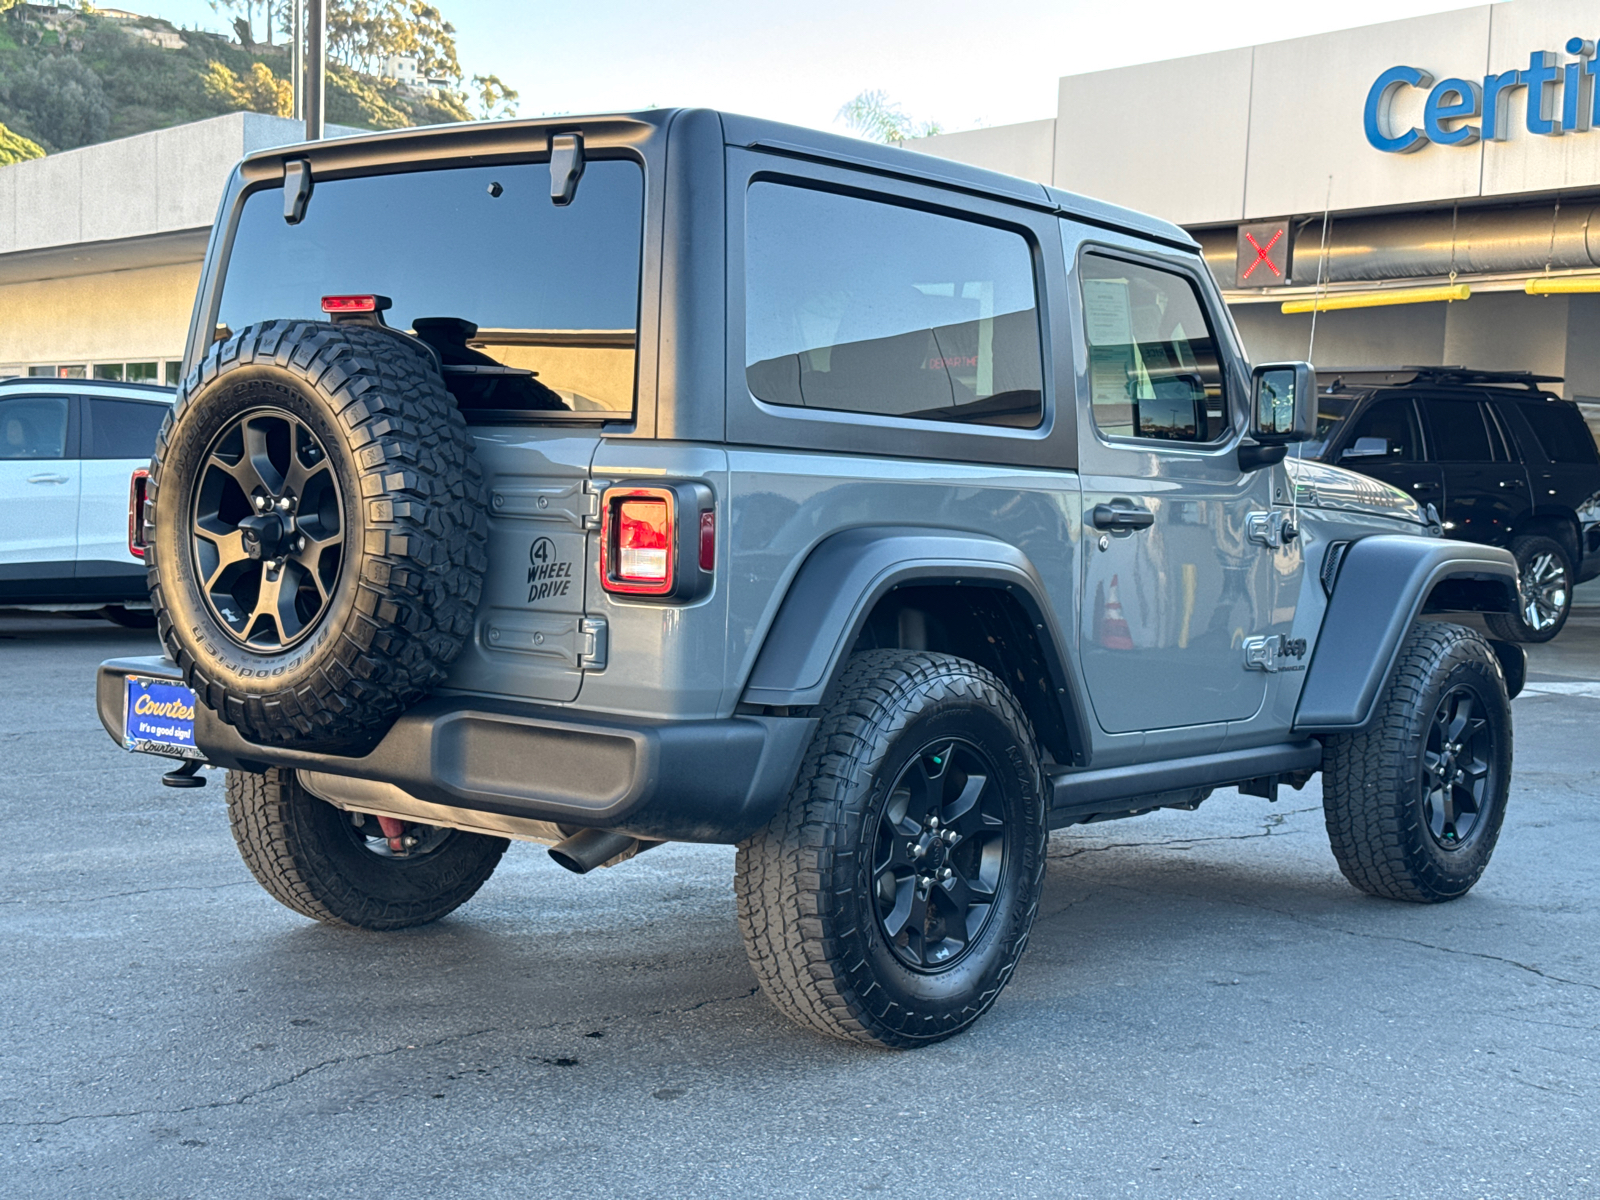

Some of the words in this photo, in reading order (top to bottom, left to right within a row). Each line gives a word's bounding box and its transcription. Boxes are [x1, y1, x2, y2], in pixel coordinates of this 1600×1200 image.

[929, 355, 979, 369] DEPARTME
[527, 562, 572, 584] WHEEL
[528, 580, 571, 603] DRIVE
[192, 623, 330, 679] BFGoodrich
[1277, 633, 1307, 660] Jeep
[135, 694, 195, 720] Courtes
[139, 722, 150, 733] It's
[151, 726, 155, 734] a
[156, 726, 174, 737] good
[174, 727, 191, 740] sign!
[142, 740, 186, 758] Courtesy
